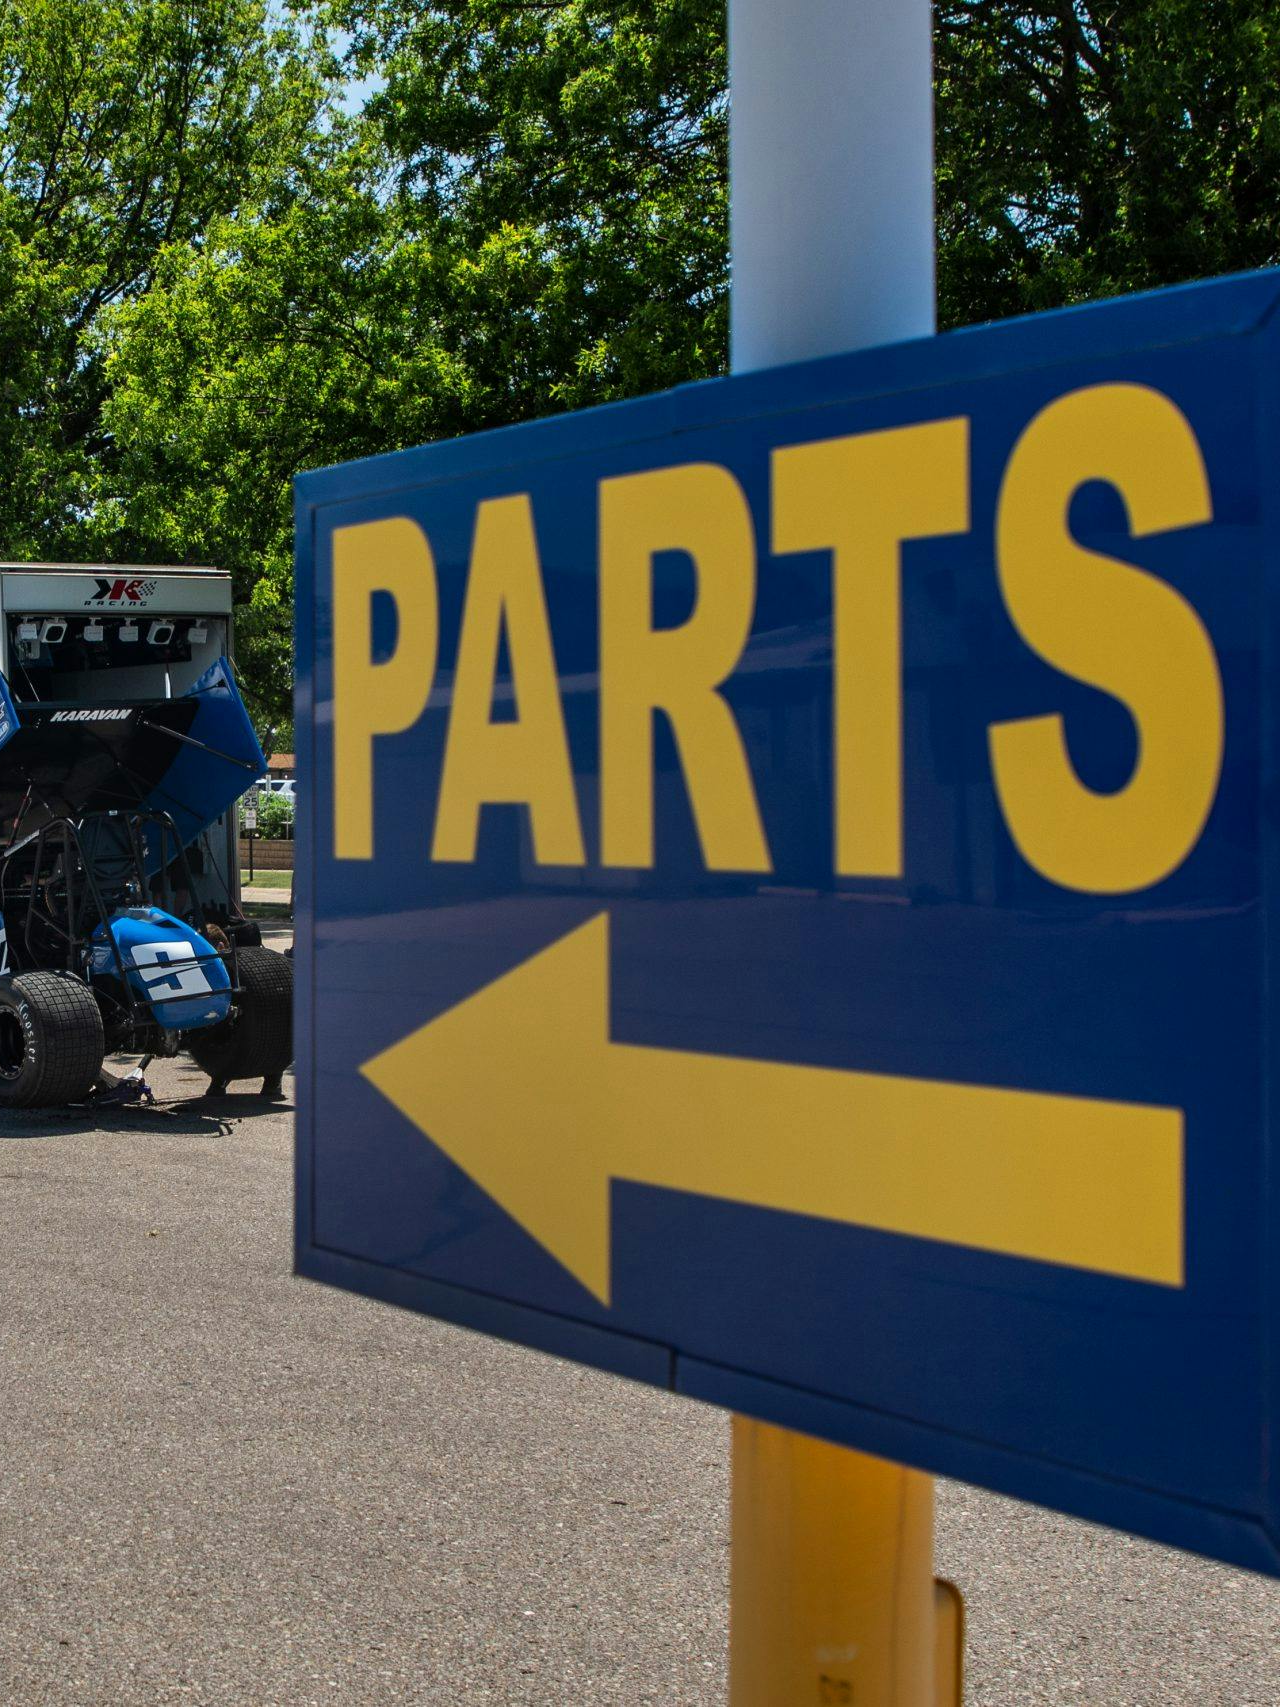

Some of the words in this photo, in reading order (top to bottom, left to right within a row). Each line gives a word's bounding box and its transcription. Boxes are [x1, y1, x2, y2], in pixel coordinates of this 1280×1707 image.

[333, 381, 1225, 893] PARTS
[50, 709, 133, 722] KARAVAN
[244, 797, 258, 806] 25
[130, 941, 213, 1001] 9
